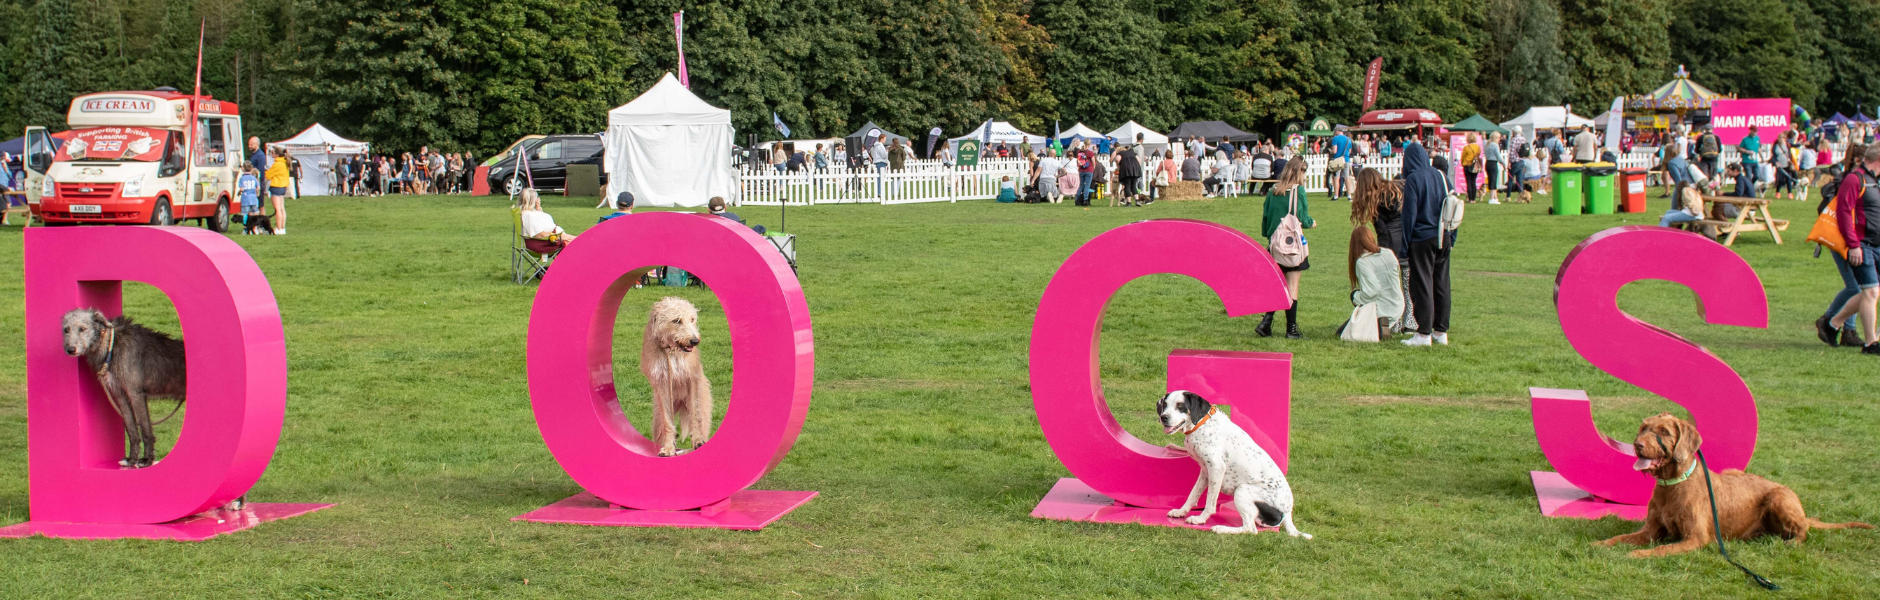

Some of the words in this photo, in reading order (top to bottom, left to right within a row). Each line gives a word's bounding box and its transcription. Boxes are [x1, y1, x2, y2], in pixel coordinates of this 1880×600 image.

[1367, 63, 1377, 102] COFFEE
[86, 100, 102, 110] ICE
[105, 100, 151, 110] CREAM
[1713, 115, 1746, 128] MAIN
[1747, 114, 1788, 128] ARENA
[78, 127, 121, 138] Supporting
[125, 127, 150, 138] British
